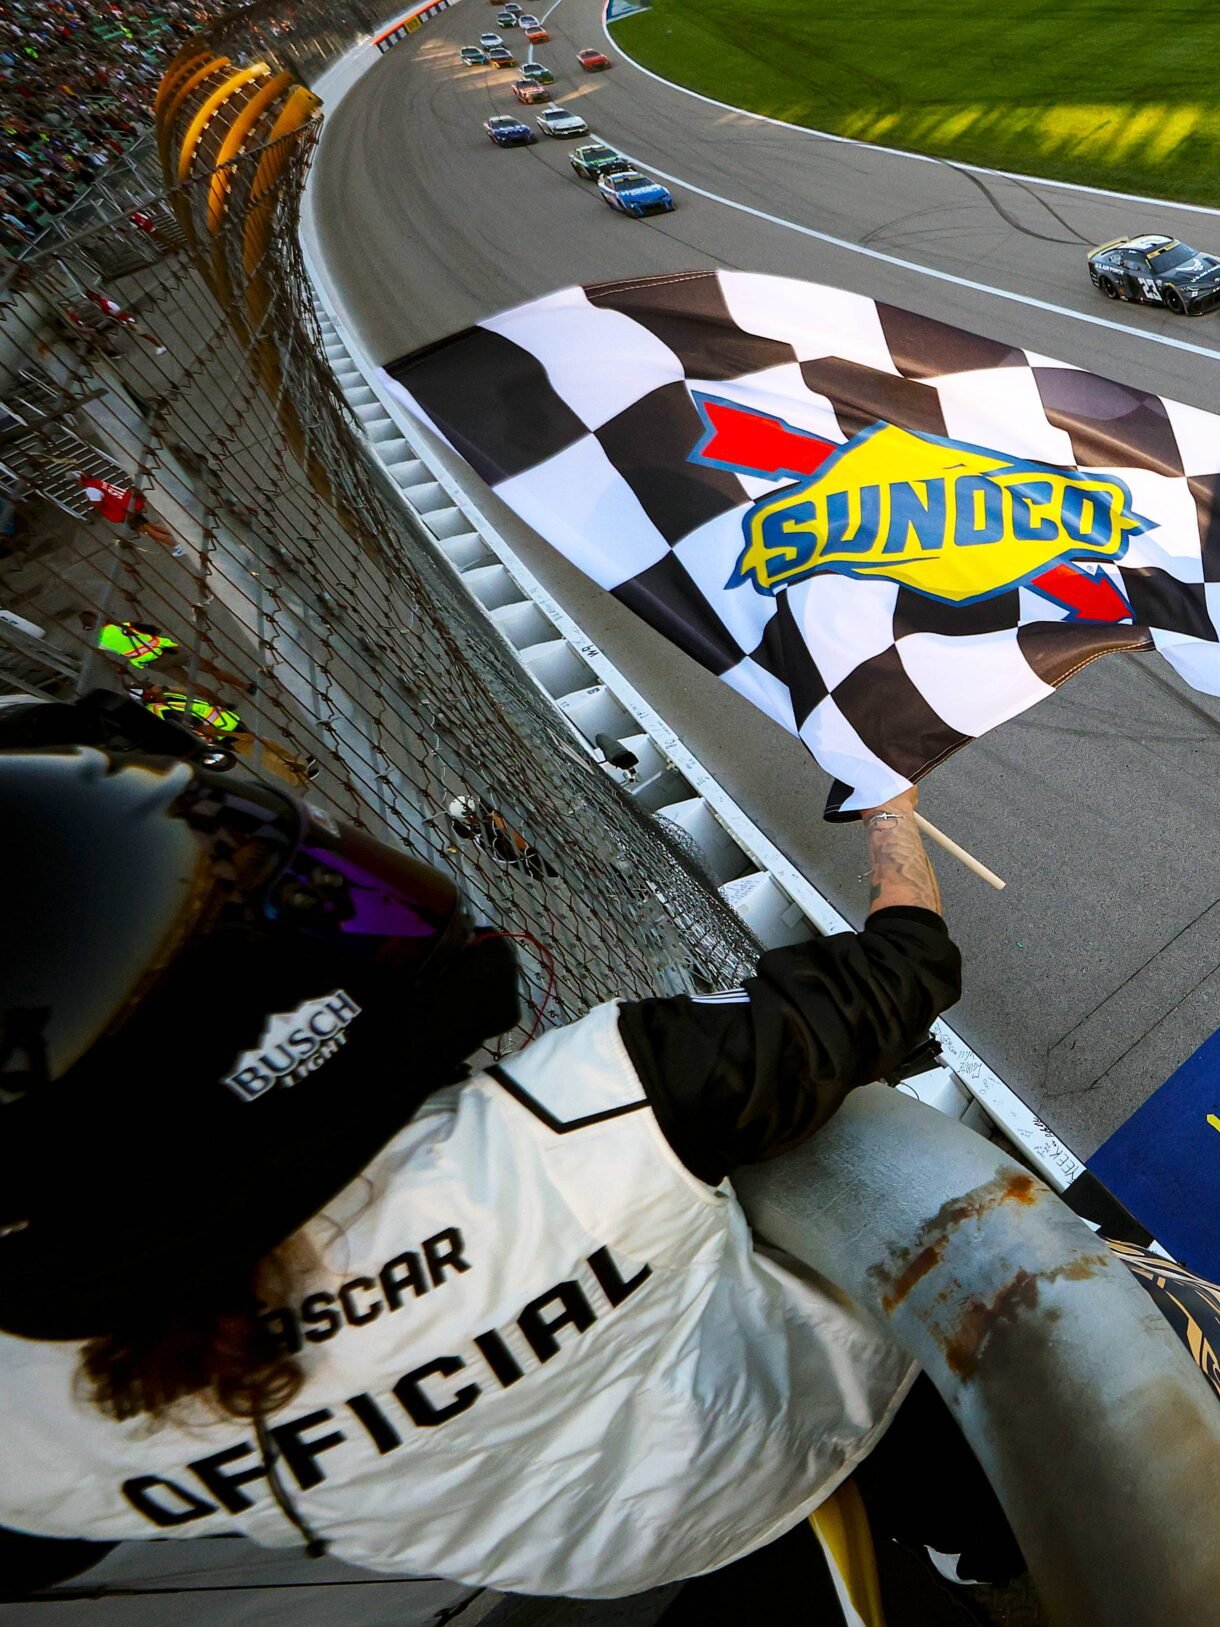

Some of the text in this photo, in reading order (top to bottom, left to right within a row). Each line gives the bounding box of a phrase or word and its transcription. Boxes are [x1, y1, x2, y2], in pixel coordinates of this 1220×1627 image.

[1137, 277, 1162, 300] 23
[761, 475, 1113, 577] SUNOCO
[231, 990, 360, 1097] BUSCH
[257, 1226, 471, 1355] ASCAR
[121, 1245, 652, 1526] OFFICIAL
